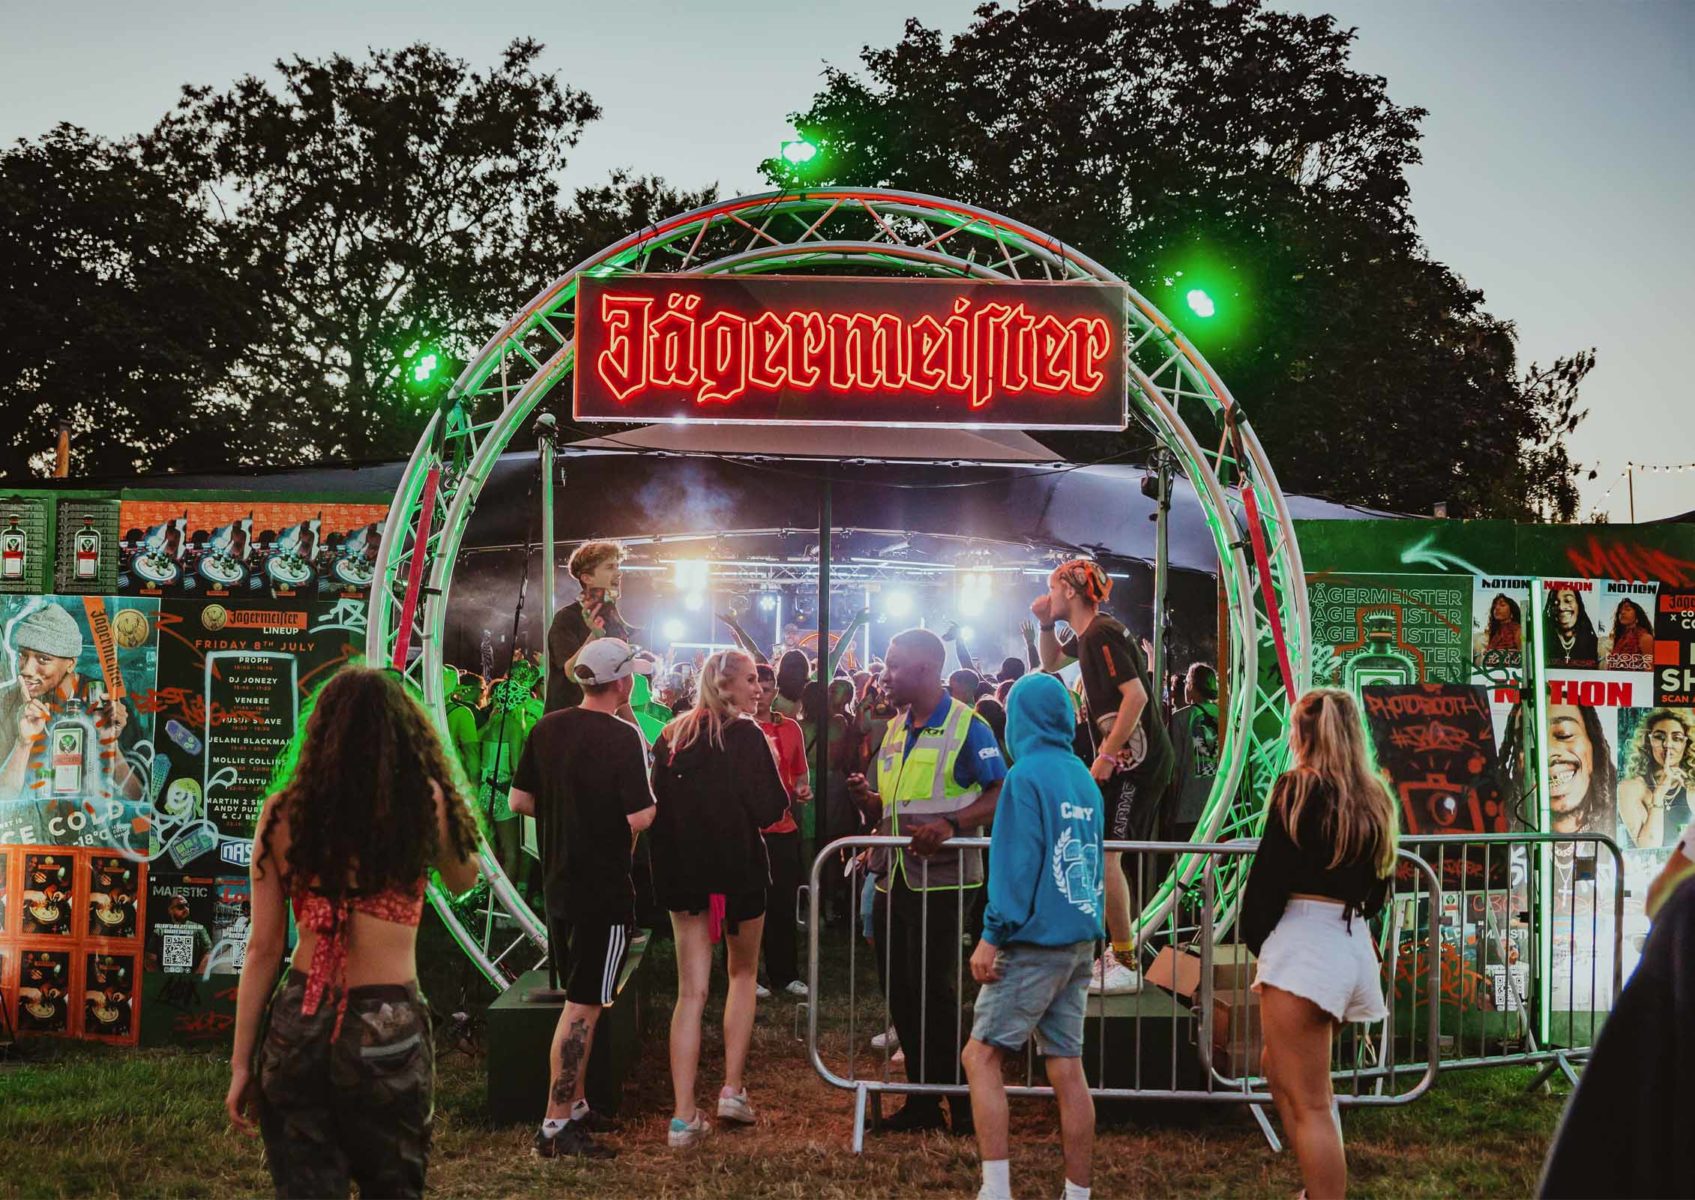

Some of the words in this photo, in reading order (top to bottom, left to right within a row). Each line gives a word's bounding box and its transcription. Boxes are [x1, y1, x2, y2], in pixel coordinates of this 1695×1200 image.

[1482, 579, 1531, 589] NOTION
[1607, 583, 1657, 594] NOTION
[263, 626, 299, 635] LINEUP
[195, 639, 247, 650] FRIDAY
[280, 641, 315, 652] JULY
[238, 656, 269, 664] PROPH
[242, 677, 278, 685] JONEZY
[1494, 679, 1633, 707] NTION
[235, 697, 270, 705] VENBEE
[1661, 694, 1689, 703] SCAN
[252, 717, 282, 725] SAVE
[212, 756, 246, 764] MOLLIE
[48, 800, 124, 836] COLD
[221, 812, 228, 820] &
[152, 886, 208, 898] MAJESTIC
